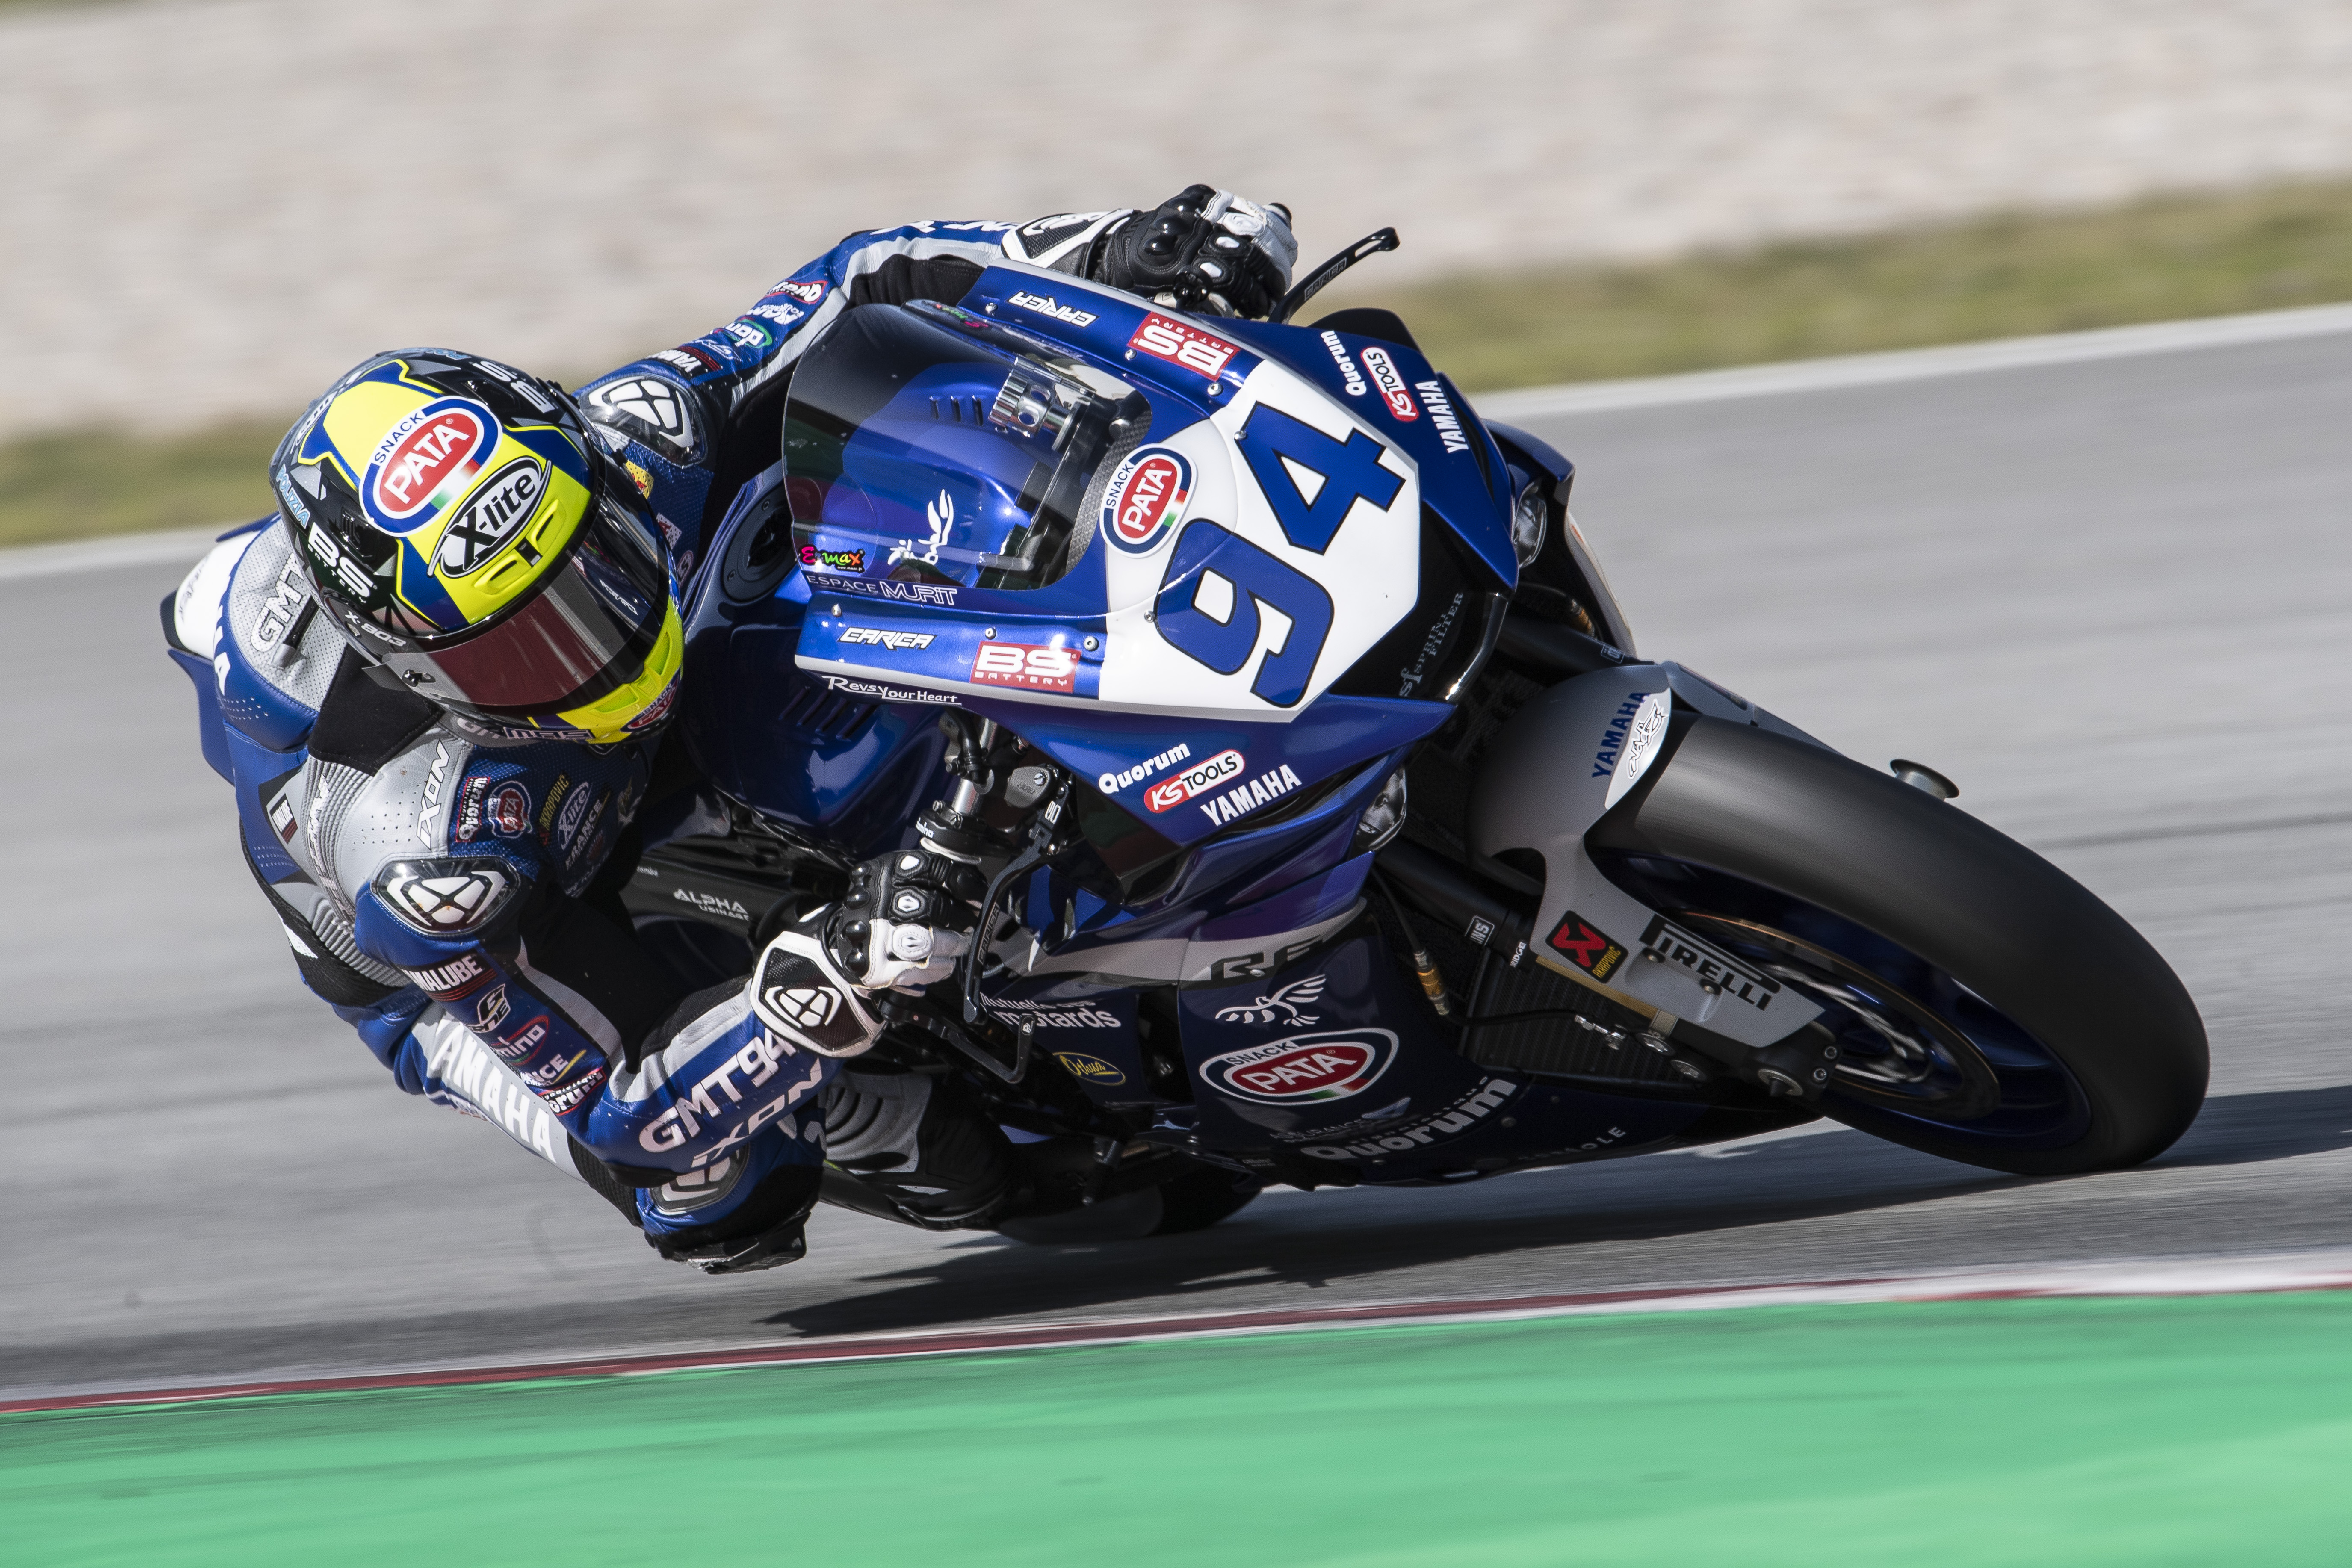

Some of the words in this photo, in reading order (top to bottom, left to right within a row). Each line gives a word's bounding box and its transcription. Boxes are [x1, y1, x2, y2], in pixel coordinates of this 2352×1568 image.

[1137, 325, 1229, 376] BS
[1151, 318, 1234, 354] BATTERY
[1321, 330, 1366, 395] Quorum
[375, 412, 423, 464] SNACK
[1415, 381, 1470, 453] YAMAHA
[385, 424, 469, 504] PATA
[1106, 464, 1133, 507] SNACK
[446, 474, 535, 571] X-lite
[1122, 468, 1172, 532] PATA
[308, 523, 374, 597] BS
[308, 544, 366, 604] BATTERY
[808, 575, 878, 594] ESPACE
[1154, 401, 1406, 708] 94
[345, 610, 406, 647] X-803
[1430, 592, 1463, 656] FILTER
[974, 671, 1067, 686] BATTERY
[977, 646, 1073, 677] BS
[1592, 691, 1650, 777] YAMAHA
[417, 739, 449, 850] IXON
[1098, 743, 1191, 794] Quorum
[1182, 756, 1237, 791] TOOLS
[1200, 764, 1302, 827] YAMAHA
[674, 889, 748, 914] ALPHA
[1639, 913, 1781, 1011] PIRELLI
[1226, 1041, 1296, 1066] SNACK
[1241, 1052, 1357, 1091] PATA
[639, 1028, 796, 1153] GMT94
[1300, 1078, 1517, 1160] Quorum
